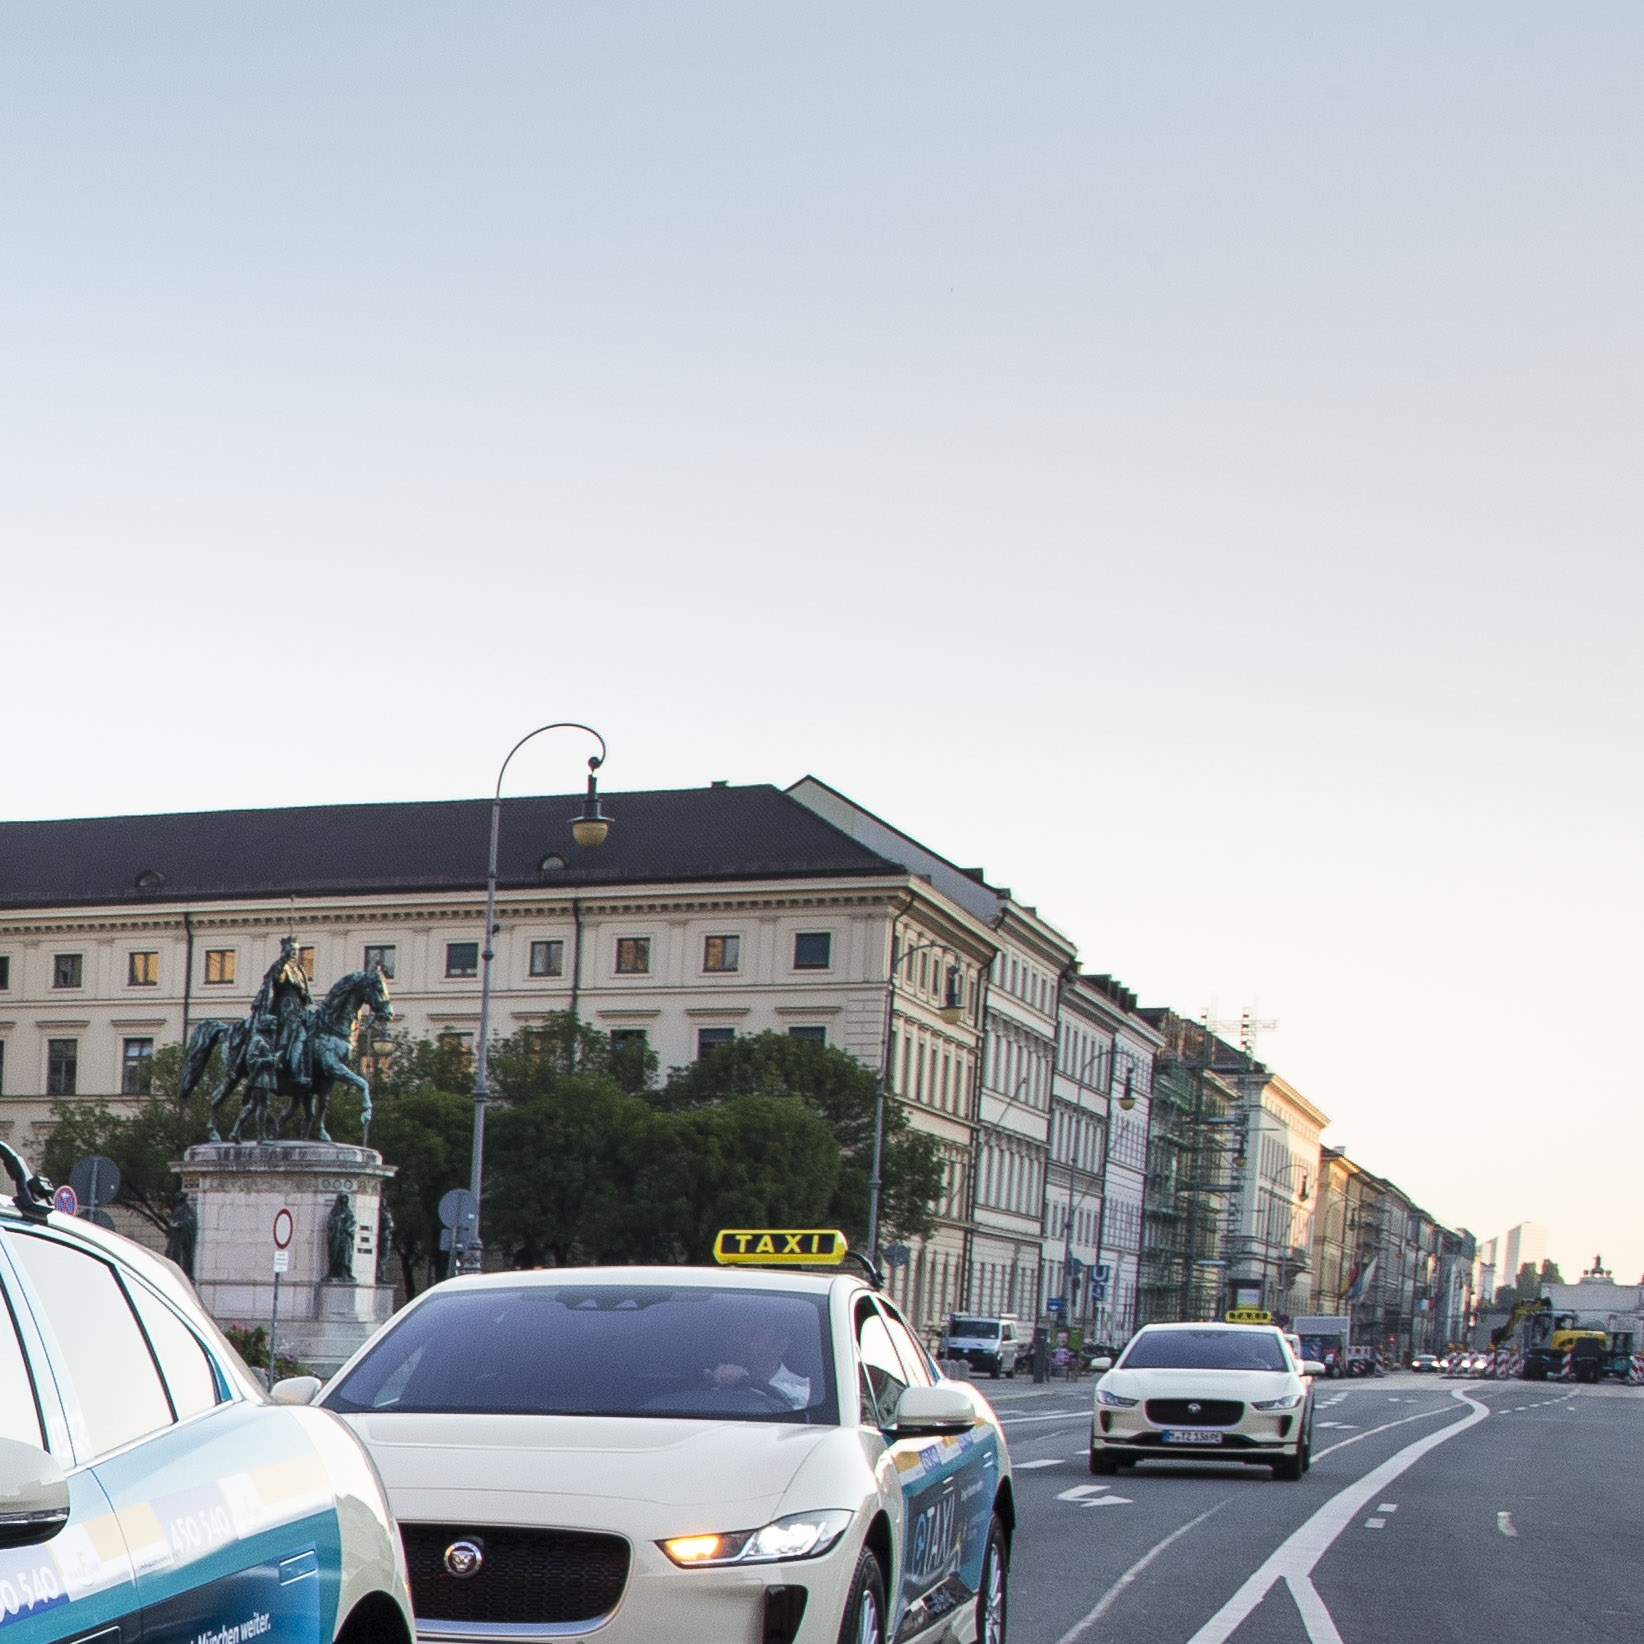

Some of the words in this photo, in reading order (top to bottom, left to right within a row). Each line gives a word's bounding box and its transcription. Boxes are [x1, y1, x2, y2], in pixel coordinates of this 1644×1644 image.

[735, 1235, 820, 1253] TAXI
[16, 1565, 59, 1611] 540
[240, 1612, 271, 1641] weiter.
